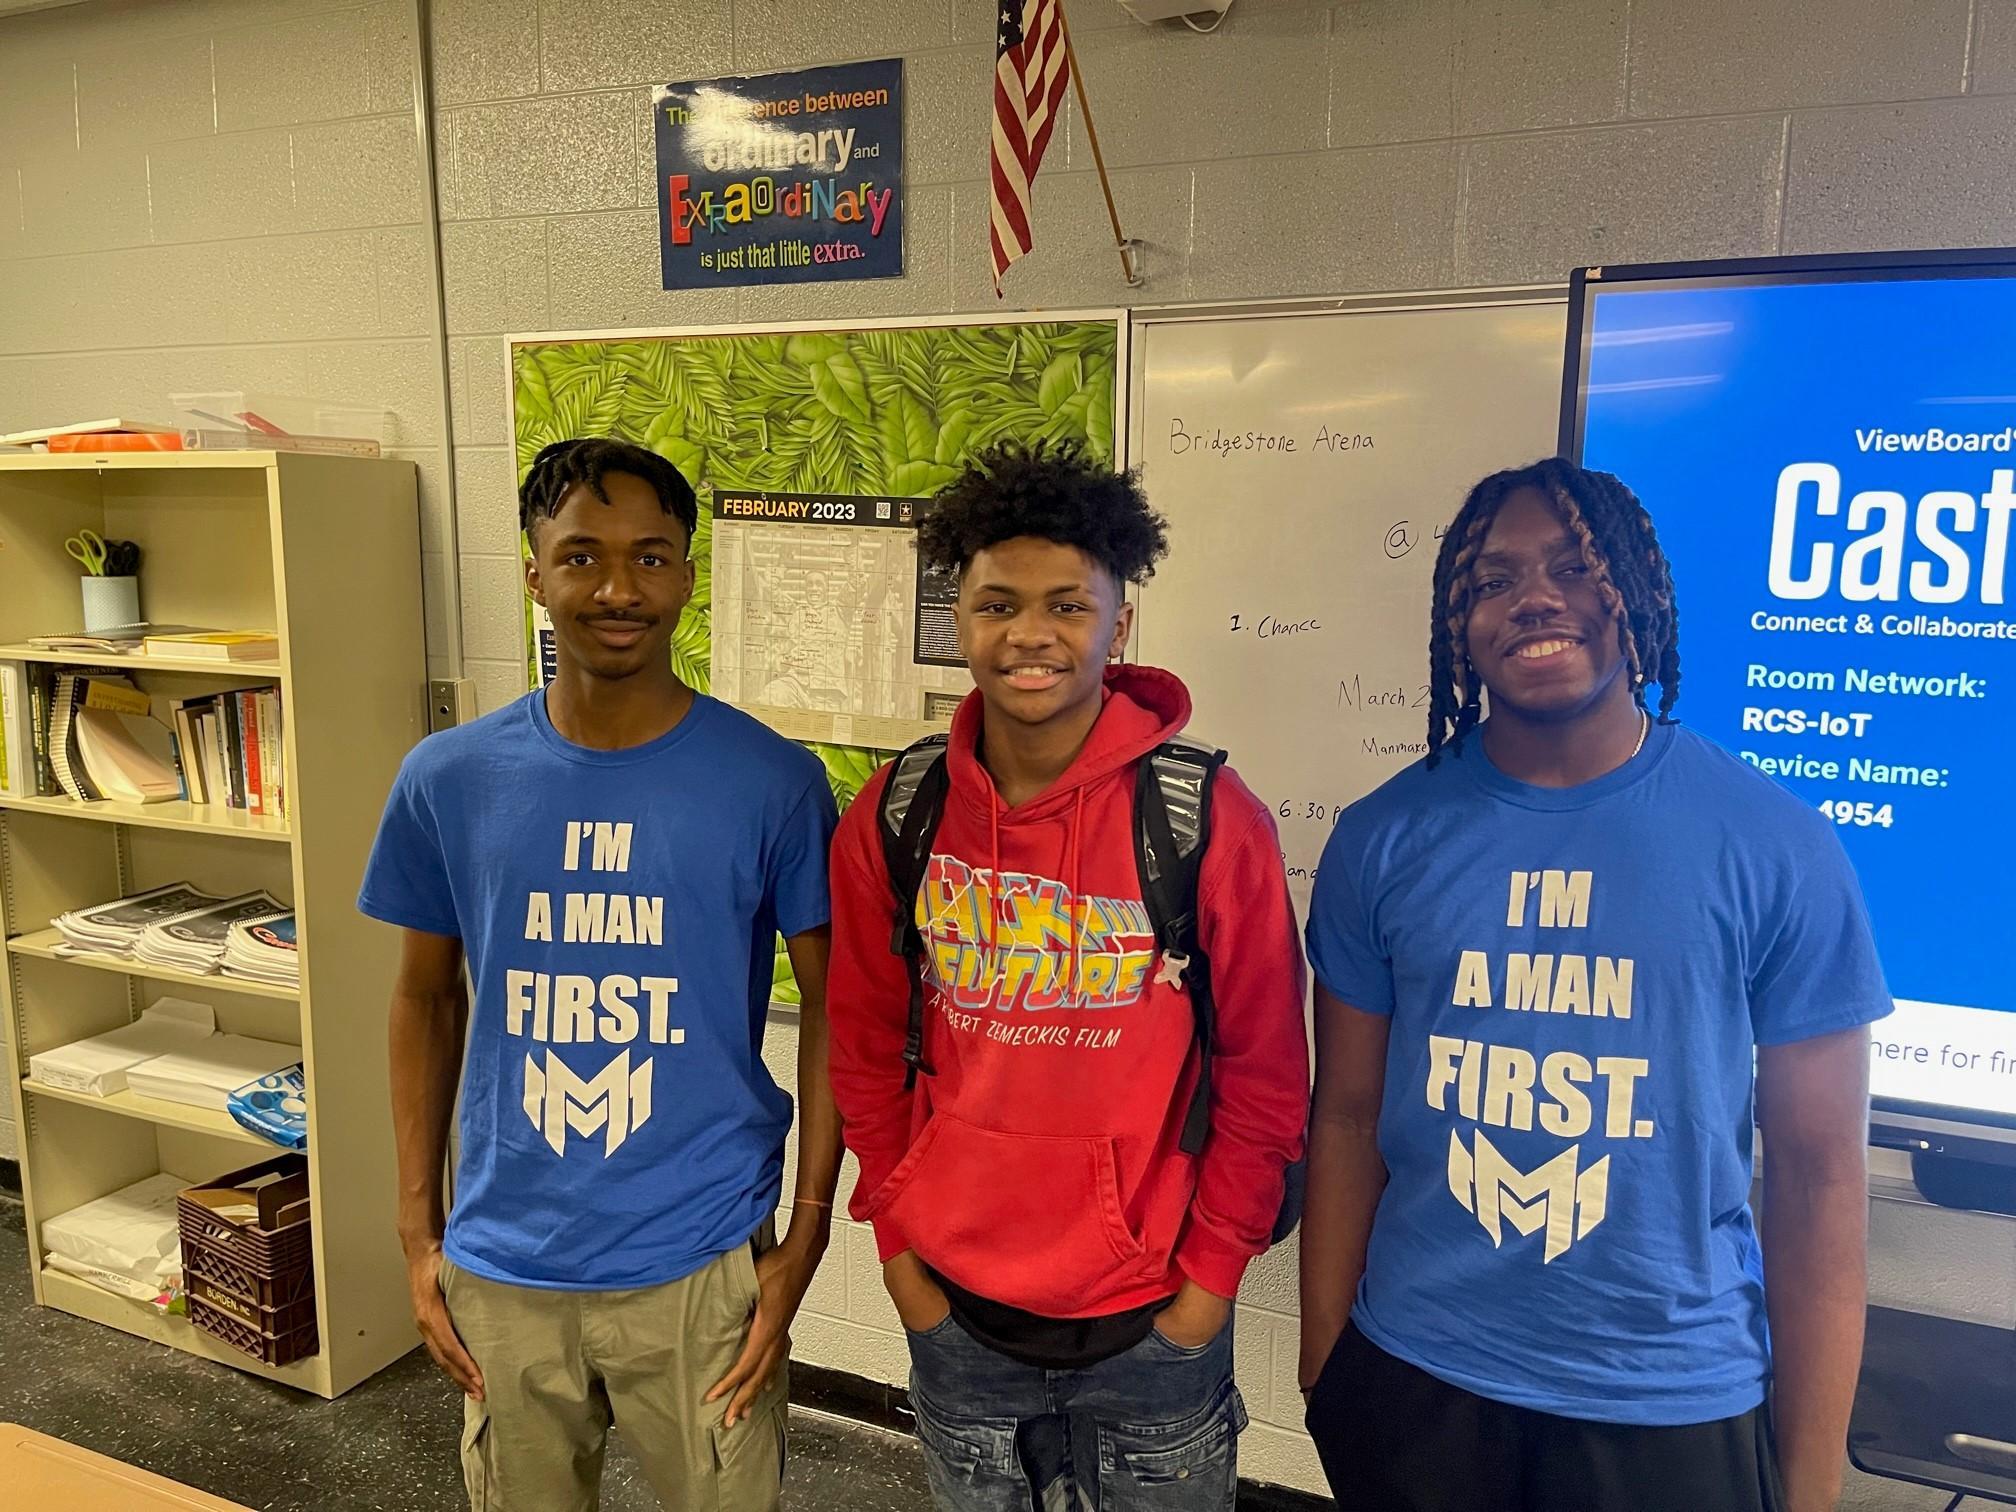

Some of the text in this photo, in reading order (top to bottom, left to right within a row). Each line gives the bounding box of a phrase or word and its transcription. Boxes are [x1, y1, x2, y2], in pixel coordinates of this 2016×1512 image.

[805, 87, 889, 113] between
[854, 143, 880, 160] and
[700, 239, 866, 273] is just that little extra.
[1312, 425, 1375, 452] Arena
[723, 499, 857, 520] FEBRUARY 2023
[1767, 462, 2016, 605] Cast
[1257, 615, 1322, 638] Chance
[1750, 611, 2016, 640] Connect & Collaborate
[1338, 674, 1405, 711] March
[1747, 664, 1987, 698] Room Network:
[1742, 707, 1873, 738] RCS-IoT
[1740, 751, 1949, 788] Device Name:
[1279, 799, 1325, 821] 6:30
[563, 821, 633, 872] I'M
[1507, 870, 1593, 927] I'M
[525, 892, 664, 946] A MAN
[1452, 950, 1634, 1019] A MAN
[506, 969, 685, 1044] FIRST.
[928, 992, 940, 1007] A
[986, 1020, 1070, 1046] ZEMECKIS
[1075, 1028, 1121, 1048] FILM
[1941, 1044, 1981, 1069] for
[1426, 1035, 1654, 1138] FIRST.
